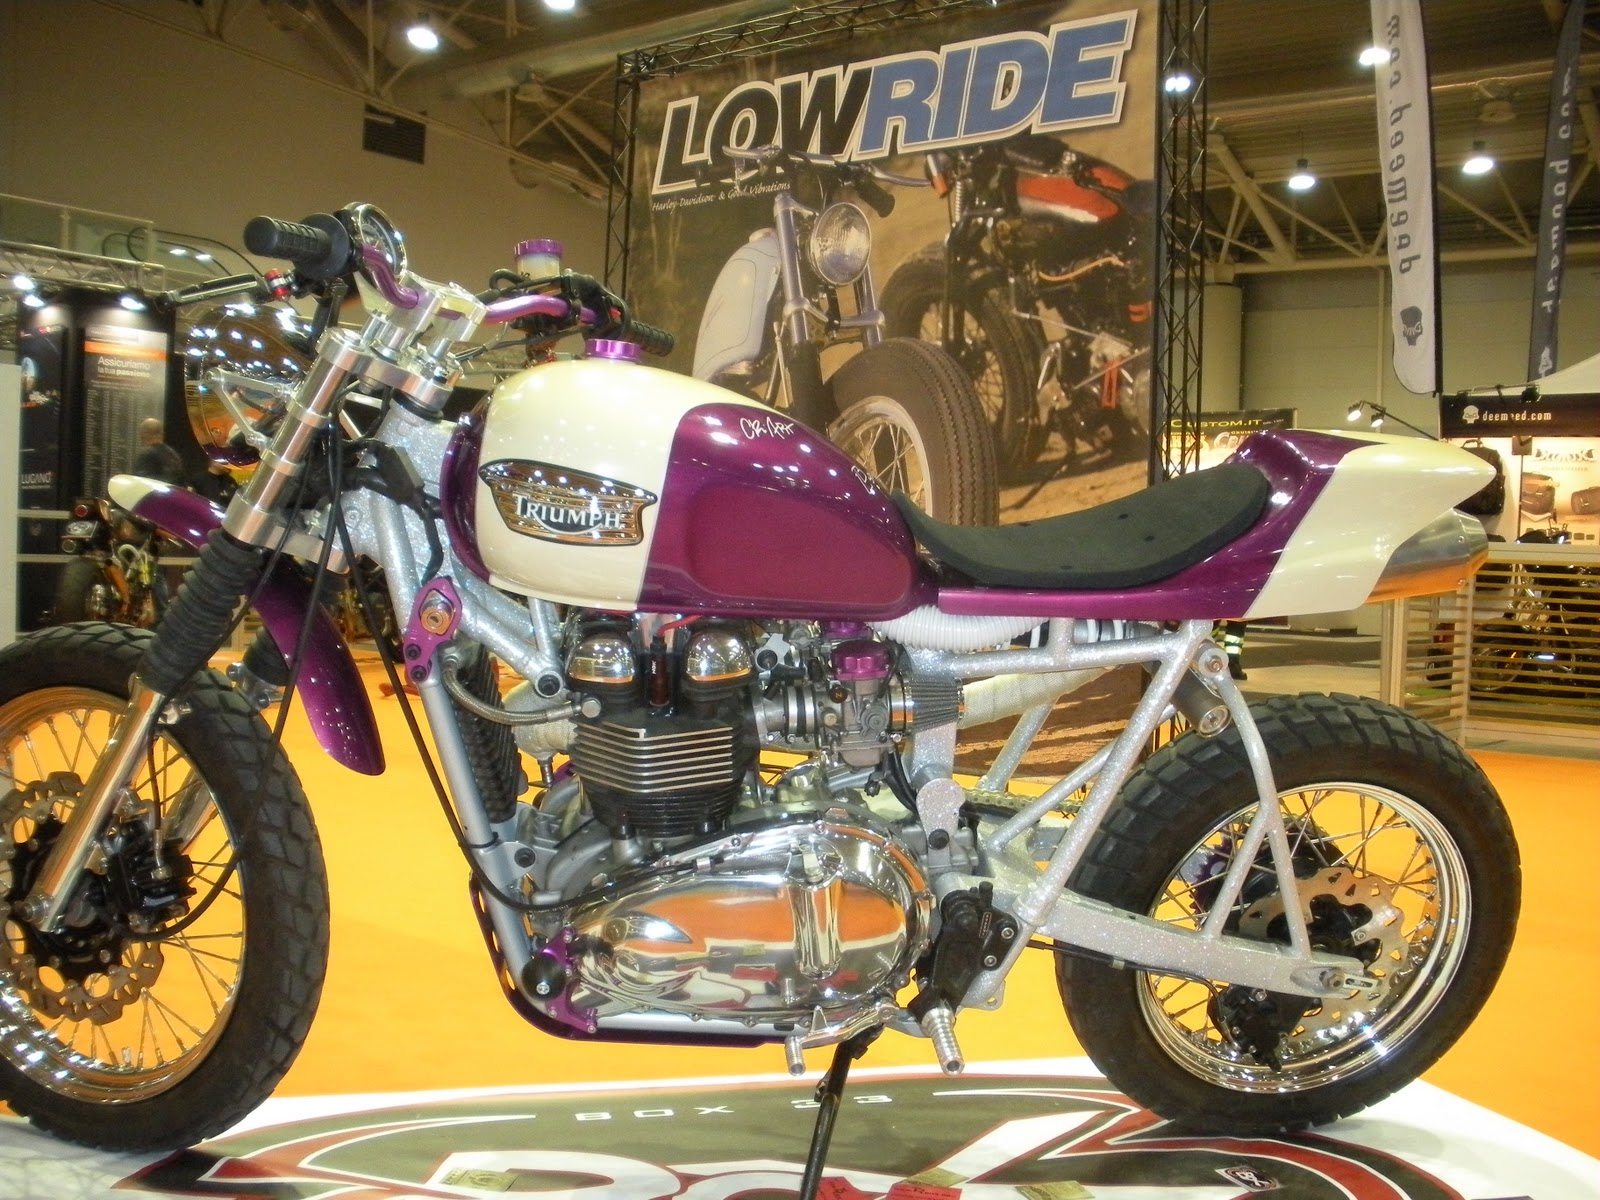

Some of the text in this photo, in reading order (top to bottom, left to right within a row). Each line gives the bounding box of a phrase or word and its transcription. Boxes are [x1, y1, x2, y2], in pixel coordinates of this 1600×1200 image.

[652, 9, 1138, 195] LOWRIDE
[718, 190, 726, 201] &
[749, 180, 791, 195] Vibrations
[97, 355, 151, 371] Assicuriamo
[116, 369, 151, 379] passione
[511, 492, 623, 529] TRIUMPH
[574, 1104, 735, 1122] BOX
